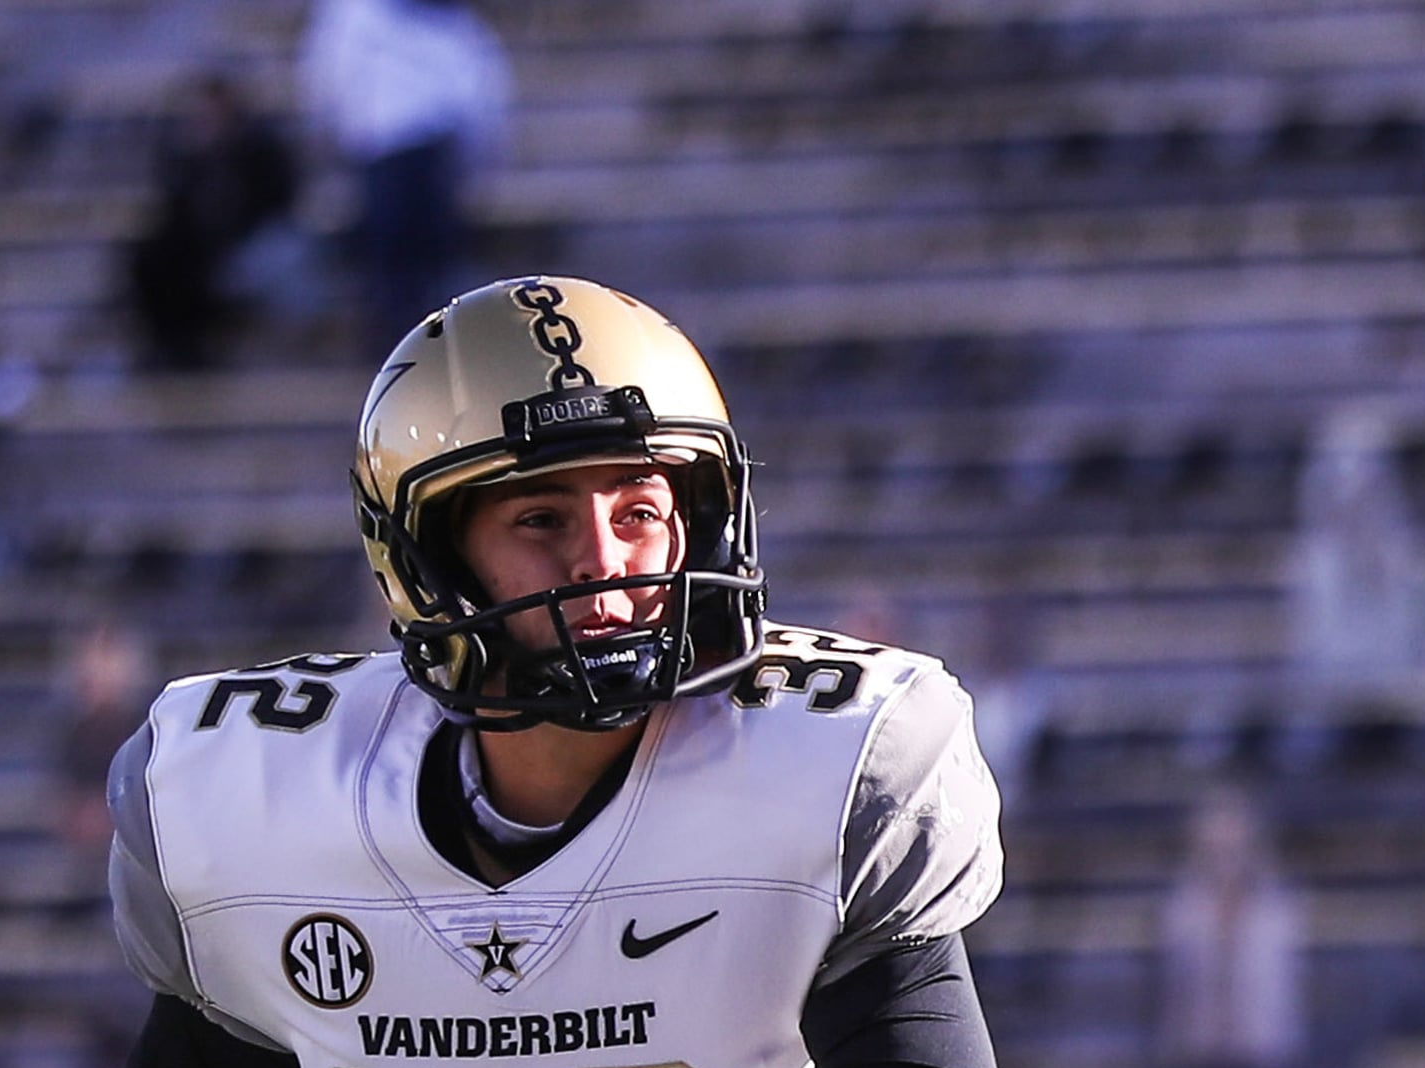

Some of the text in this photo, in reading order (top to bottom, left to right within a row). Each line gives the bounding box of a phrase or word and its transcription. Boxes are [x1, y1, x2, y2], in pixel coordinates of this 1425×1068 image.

[581, 650, 638, 670] Riddell
[289, 920, 365, 1002] SEC
[487, 945, 506, 966] V
[357, 1002, 656, 1059] VANDERBILT
